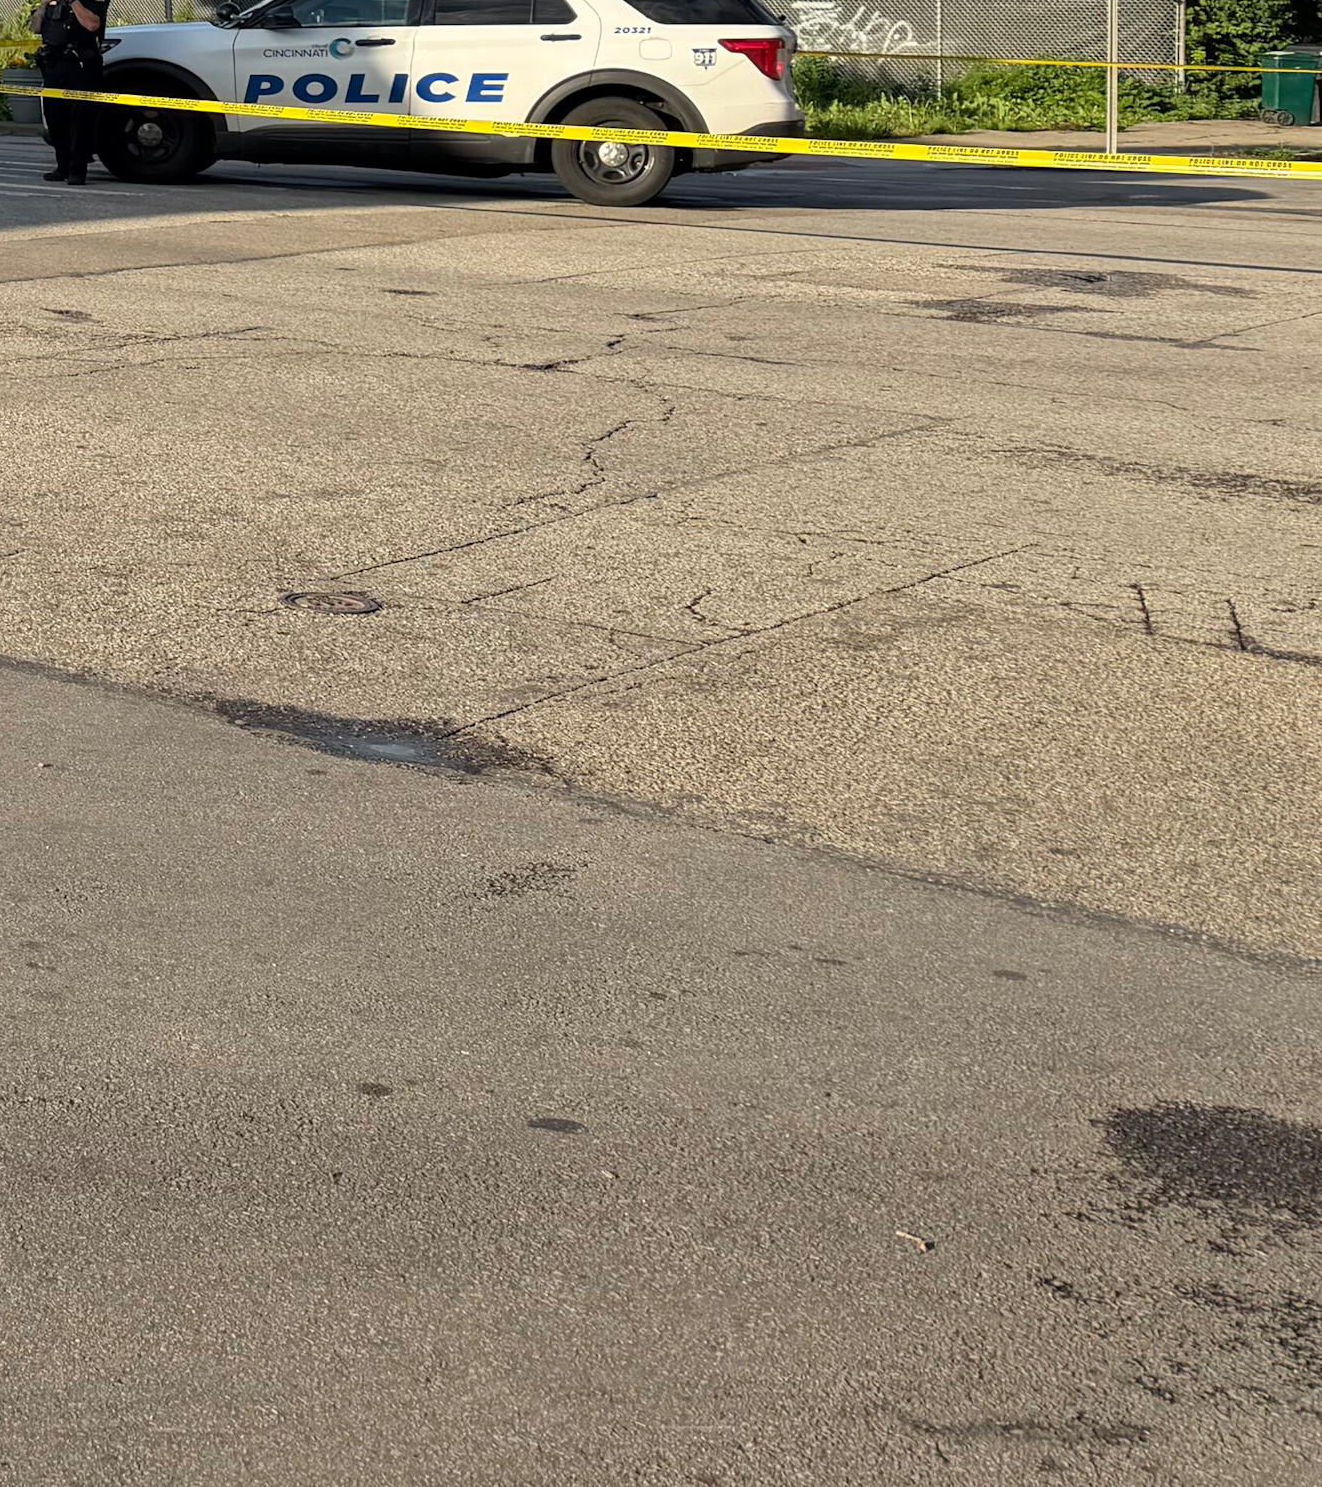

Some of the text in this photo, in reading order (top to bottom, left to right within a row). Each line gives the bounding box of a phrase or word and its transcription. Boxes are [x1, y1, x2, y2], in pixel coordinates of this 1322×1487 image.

[263, 48, 328, 58] CINCINNATI
[694, 52, 716, 64] 911
[244, 72, 509, 104] POLICE
